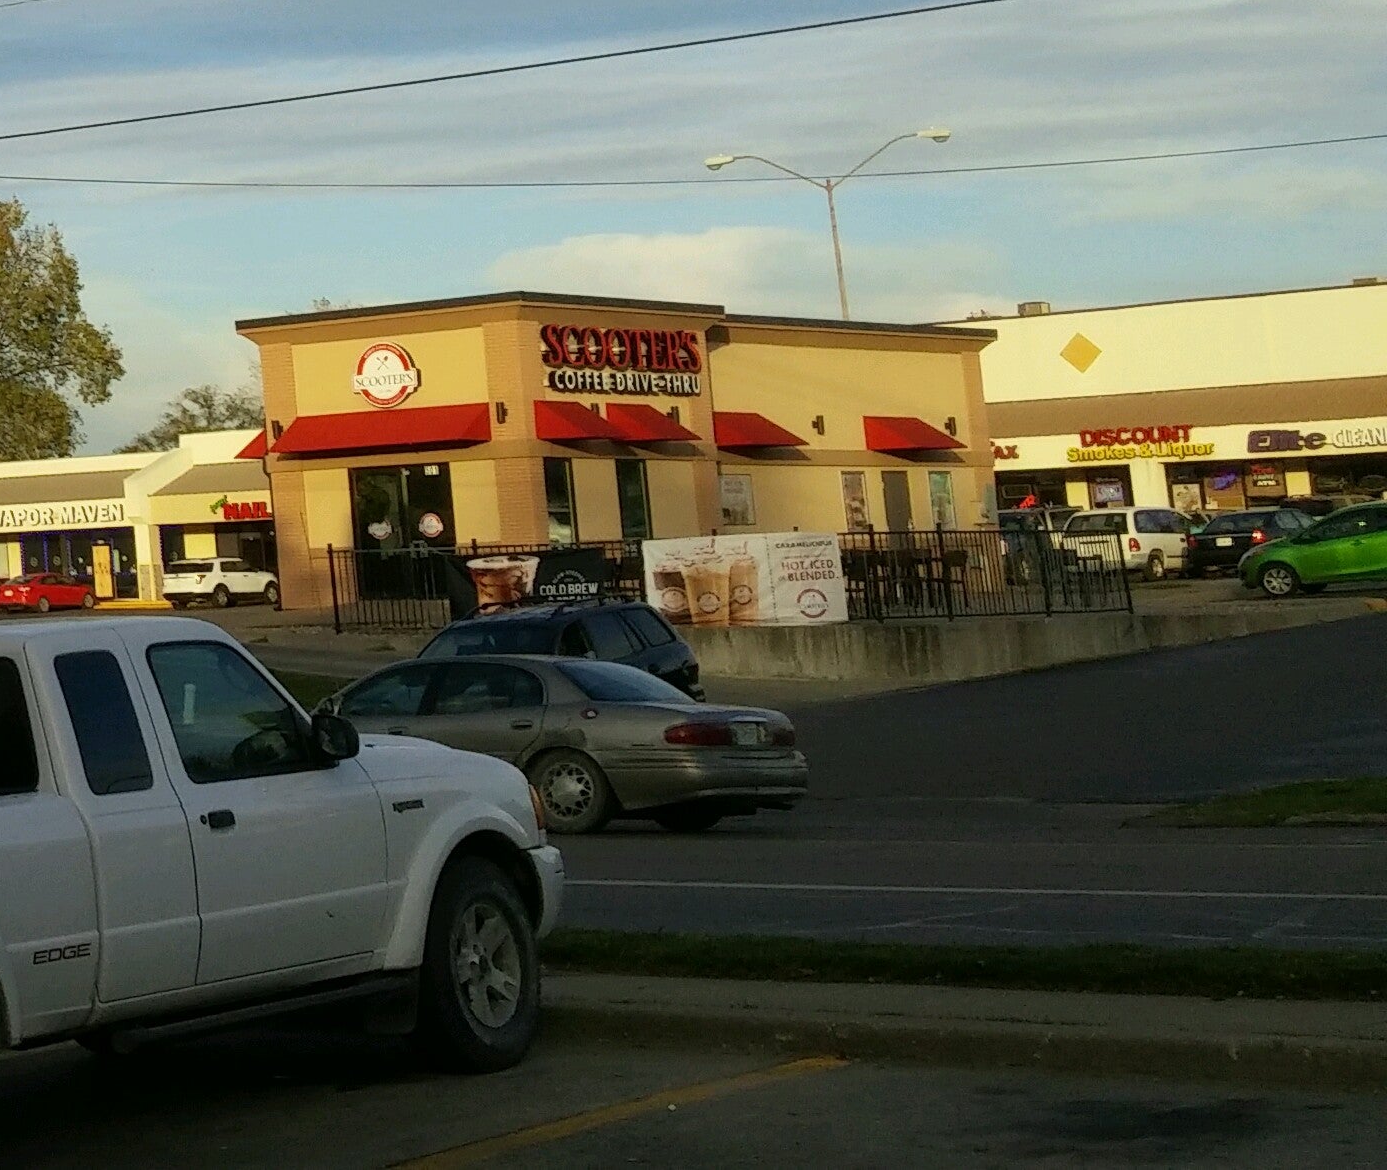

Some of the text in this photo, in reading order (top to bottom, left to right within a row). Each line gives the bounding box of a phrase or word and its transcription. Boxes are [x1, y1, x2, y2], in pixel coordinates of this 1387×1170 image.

[543, 324, 702, 373] SCOOTER'S
[555, 371, 611, 390] COFFEE
[1079, 424, 1193, 447] DISCOUNT
[990, 441, 1019, 459] AX
[1067, 441, 1214, 462] Smokes & Liquor
[59, 504, 125, 524] MAVEN
[539, 582, 599, 596] COLD BREW
[33, 943, 92, 965] EDGE
